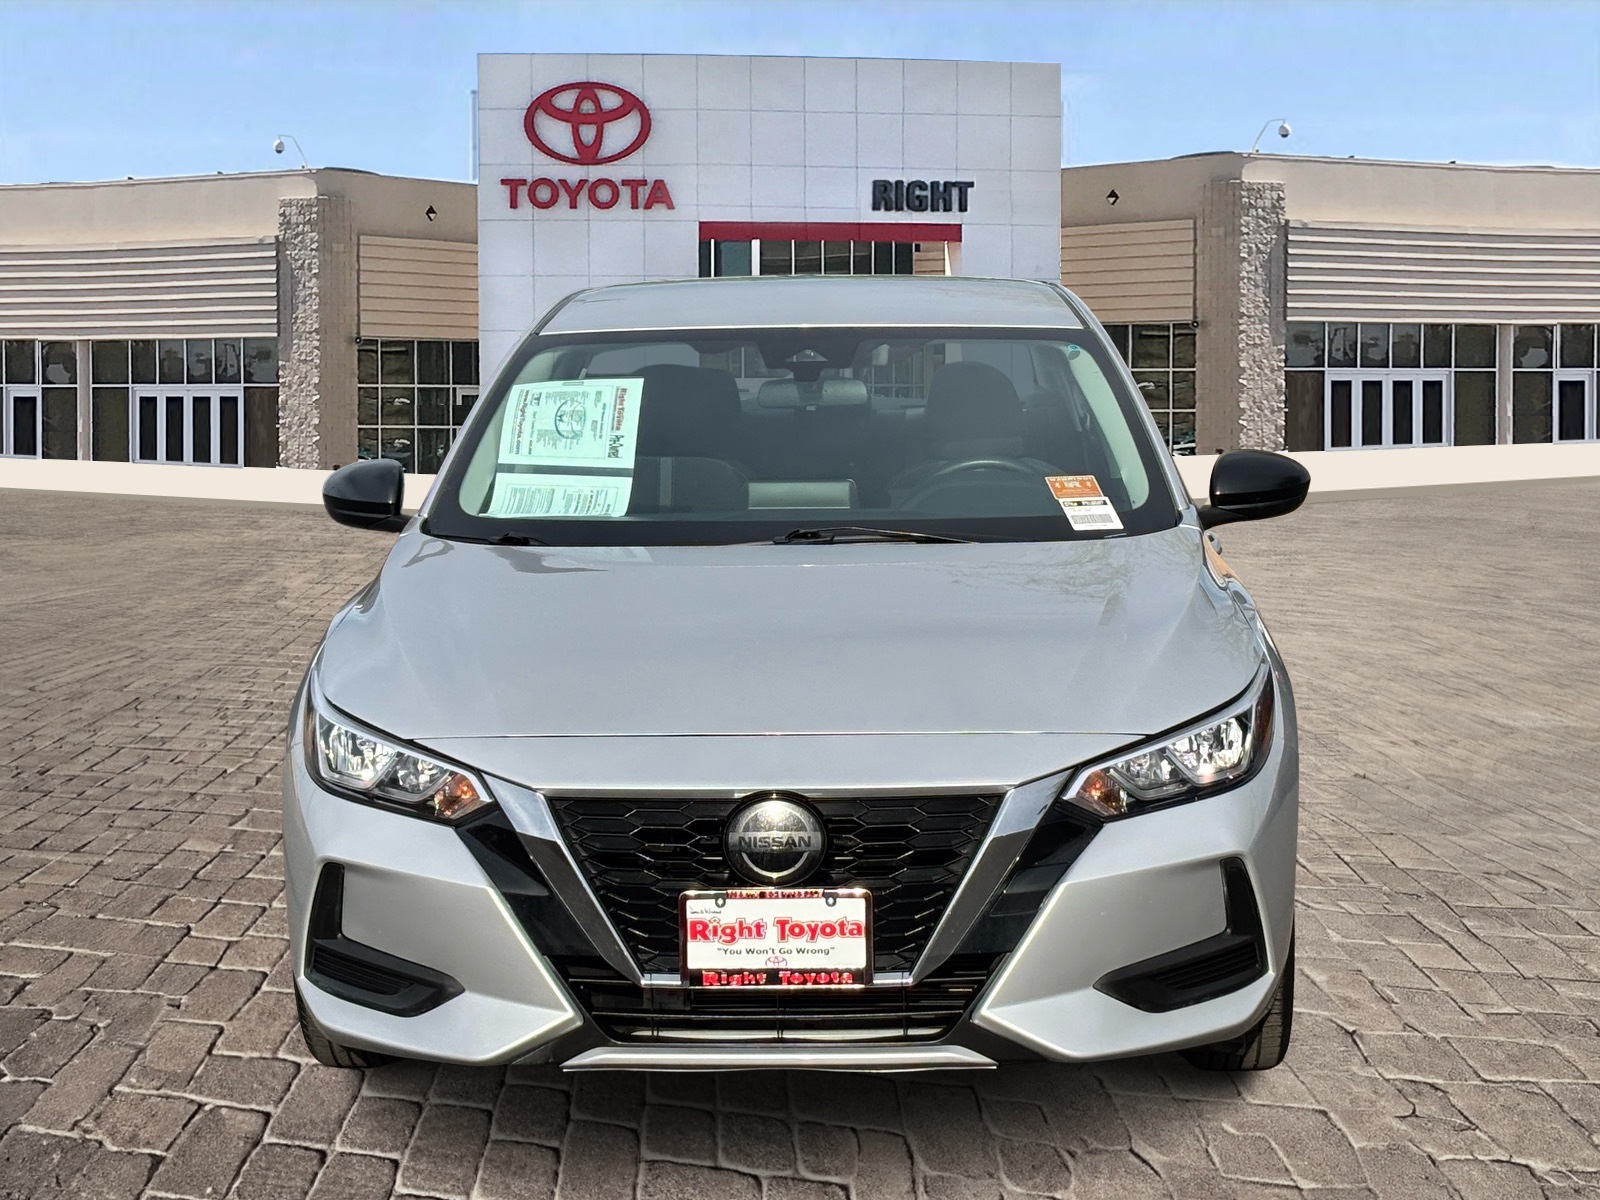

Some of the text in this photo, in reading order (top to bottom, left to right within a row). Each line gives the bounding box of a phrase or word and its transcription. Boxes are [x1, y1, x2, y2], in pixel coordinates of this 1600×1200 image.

[500, 178, 675, 210] TOYOTA
[872, 180, 975, 212] RIGHT
[738, 836, 811, 848] NISSAN
[688, 916, 865, 945] Right Toyota
[745, 947, 775, 955] Won't
[779, 947, 793, 955] Go
[702, 970, 853, 986] Right Toyota
